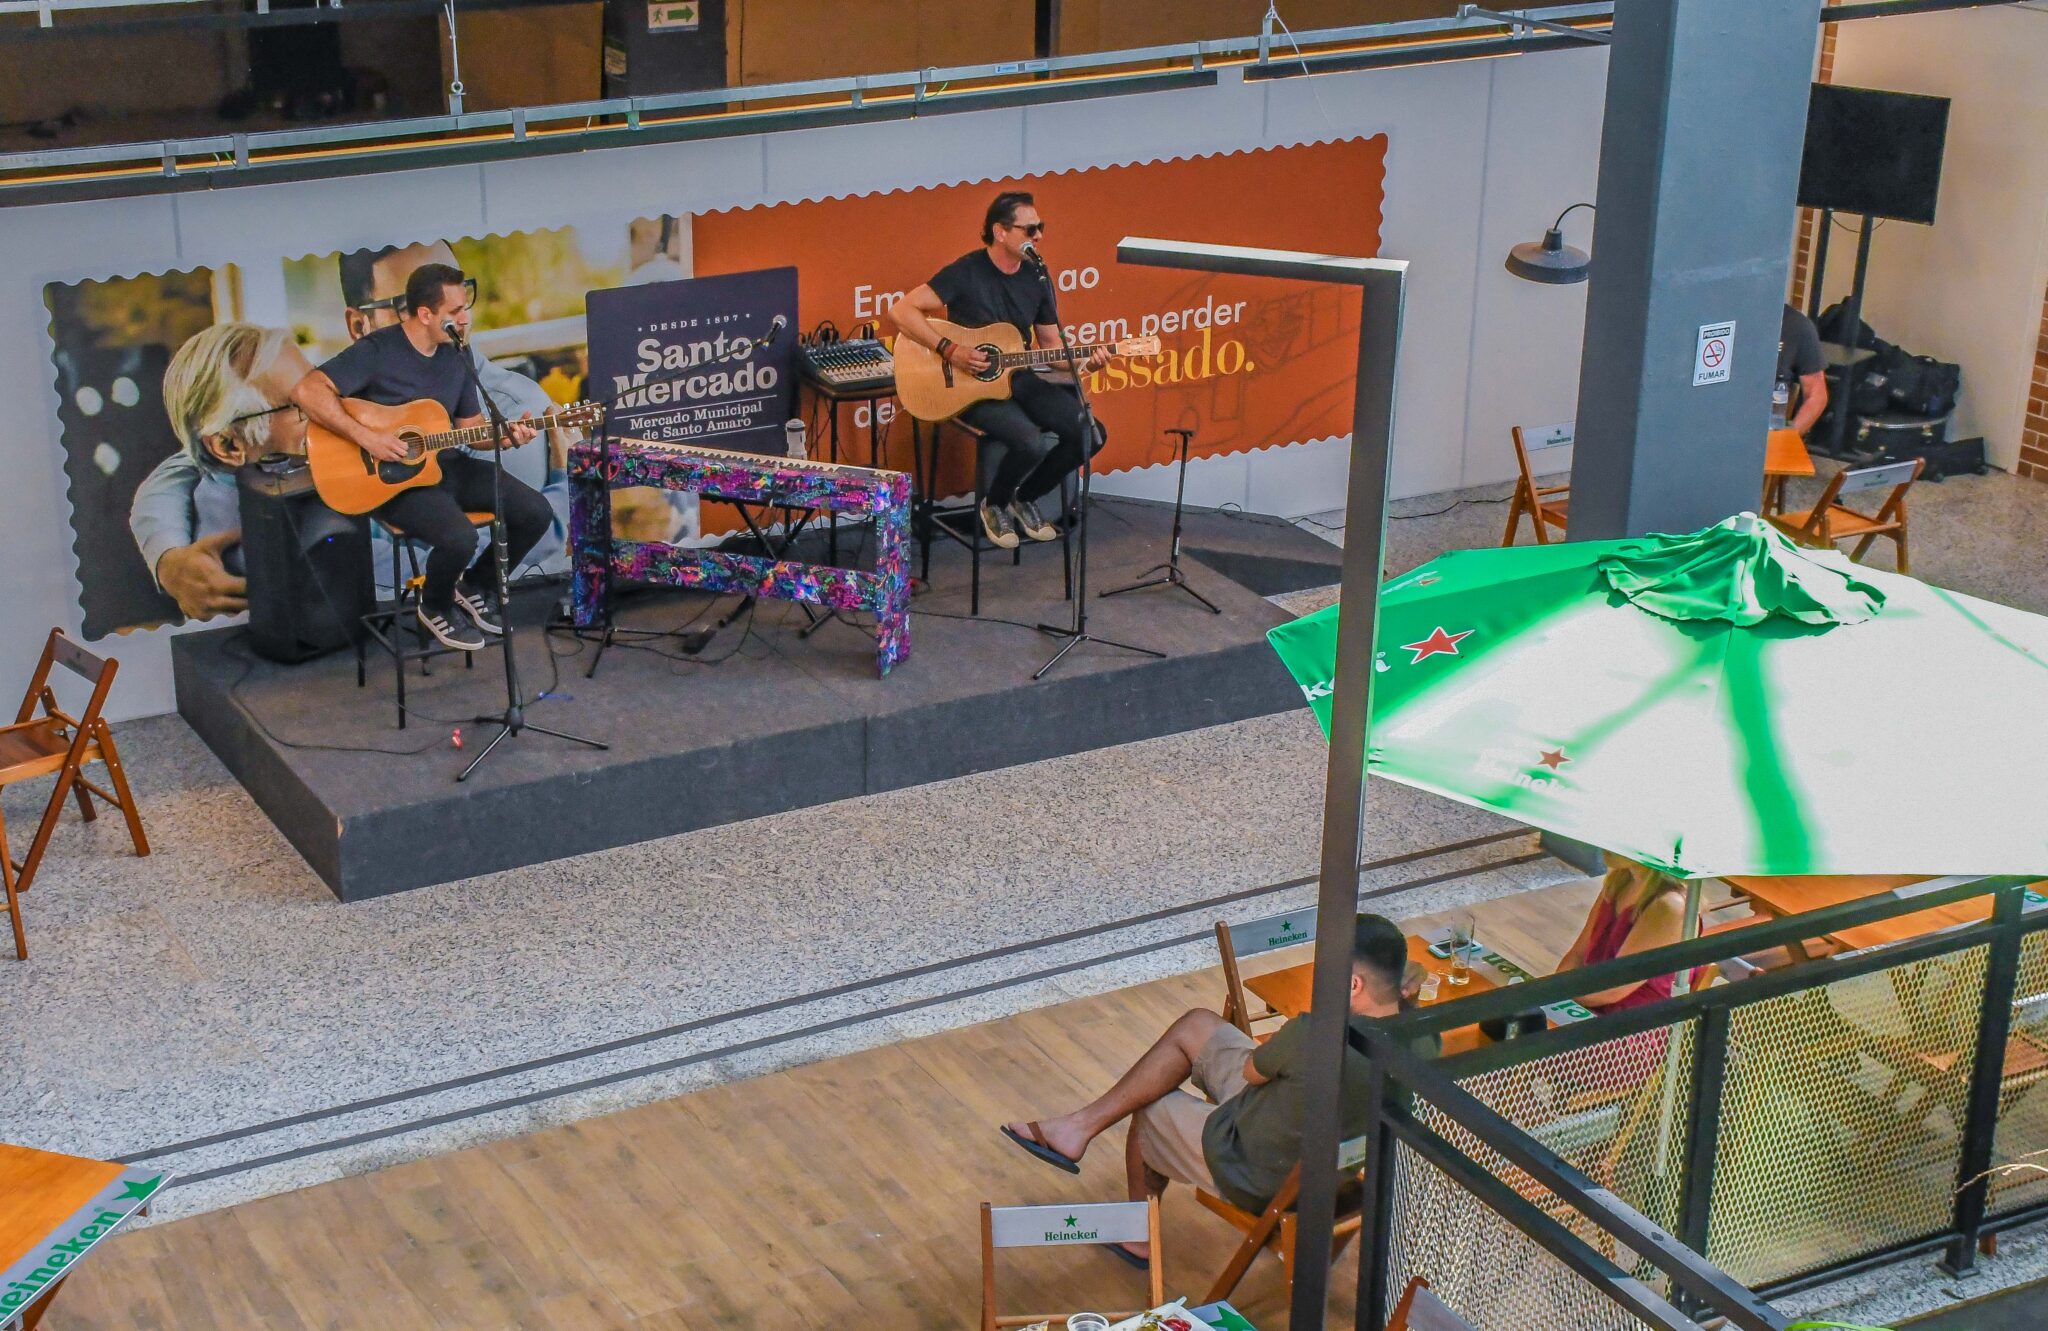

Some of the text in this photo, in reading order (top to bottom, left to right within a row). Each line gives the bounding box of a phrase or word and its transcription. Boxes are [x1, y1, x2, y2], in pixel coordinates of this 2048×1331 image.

[1058, 266, 1100, 292] ao
[650, 314, 739, 332] DESDE 1897
[1064, 295, 1247, 347] sem perder
[636, 331, 753, 372] Santo
[1082, 327, 1255, 394] assado.
[613, 362, 778, 410] Mercado
[1698, 370, 1725, 380] FUMAR
[630, 401, 763, 430] Mercado Municipal
[642, 417, 752, 440] de Santo Amaro
[1268, 931, 1308, 946] Heineken
[1044, 1230, 1098, 1242] Heineken
